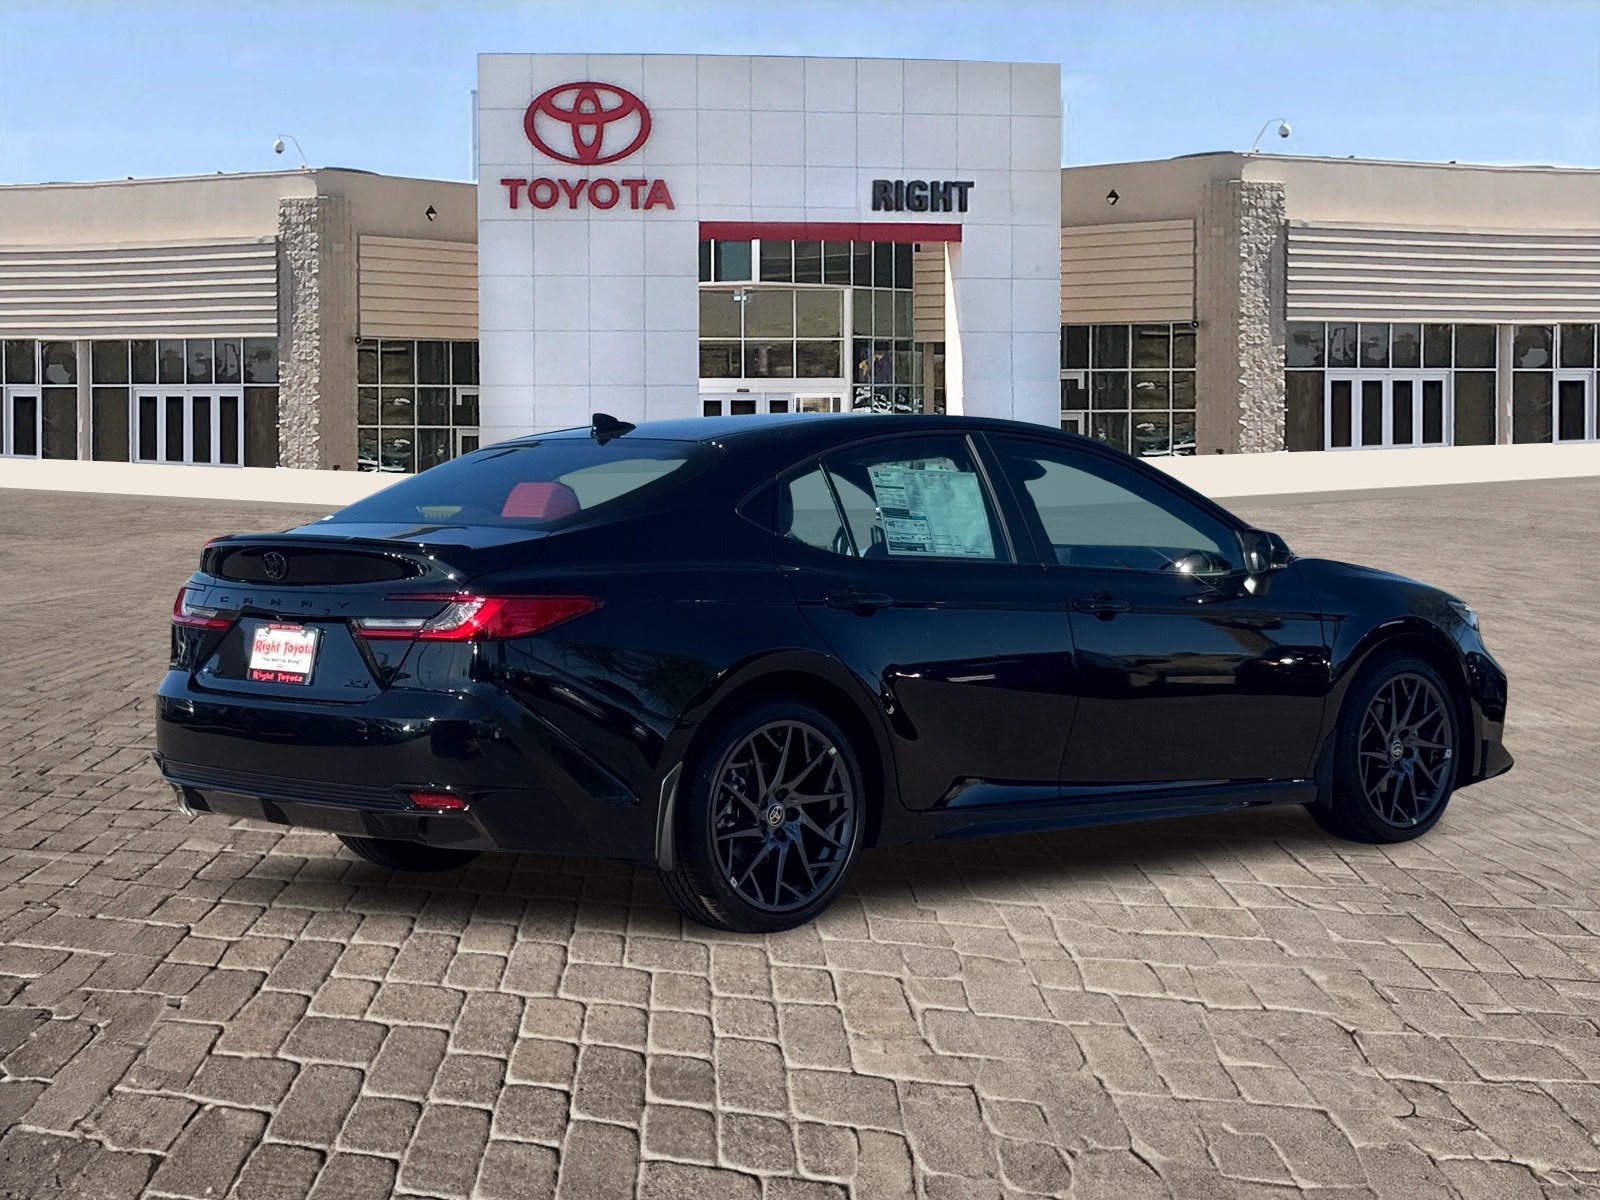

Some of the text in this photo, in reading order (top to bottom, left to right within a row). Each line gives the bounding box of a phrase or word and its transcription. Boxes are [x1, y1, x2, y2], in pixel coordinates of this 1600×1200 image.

[500, 177, 675, 210] TOYOTA
[872, 179, 975, 212] RIGHT
[255, 639, 314, 657] Right Toyota
[252, 670, 303, 682] Right Toyota
